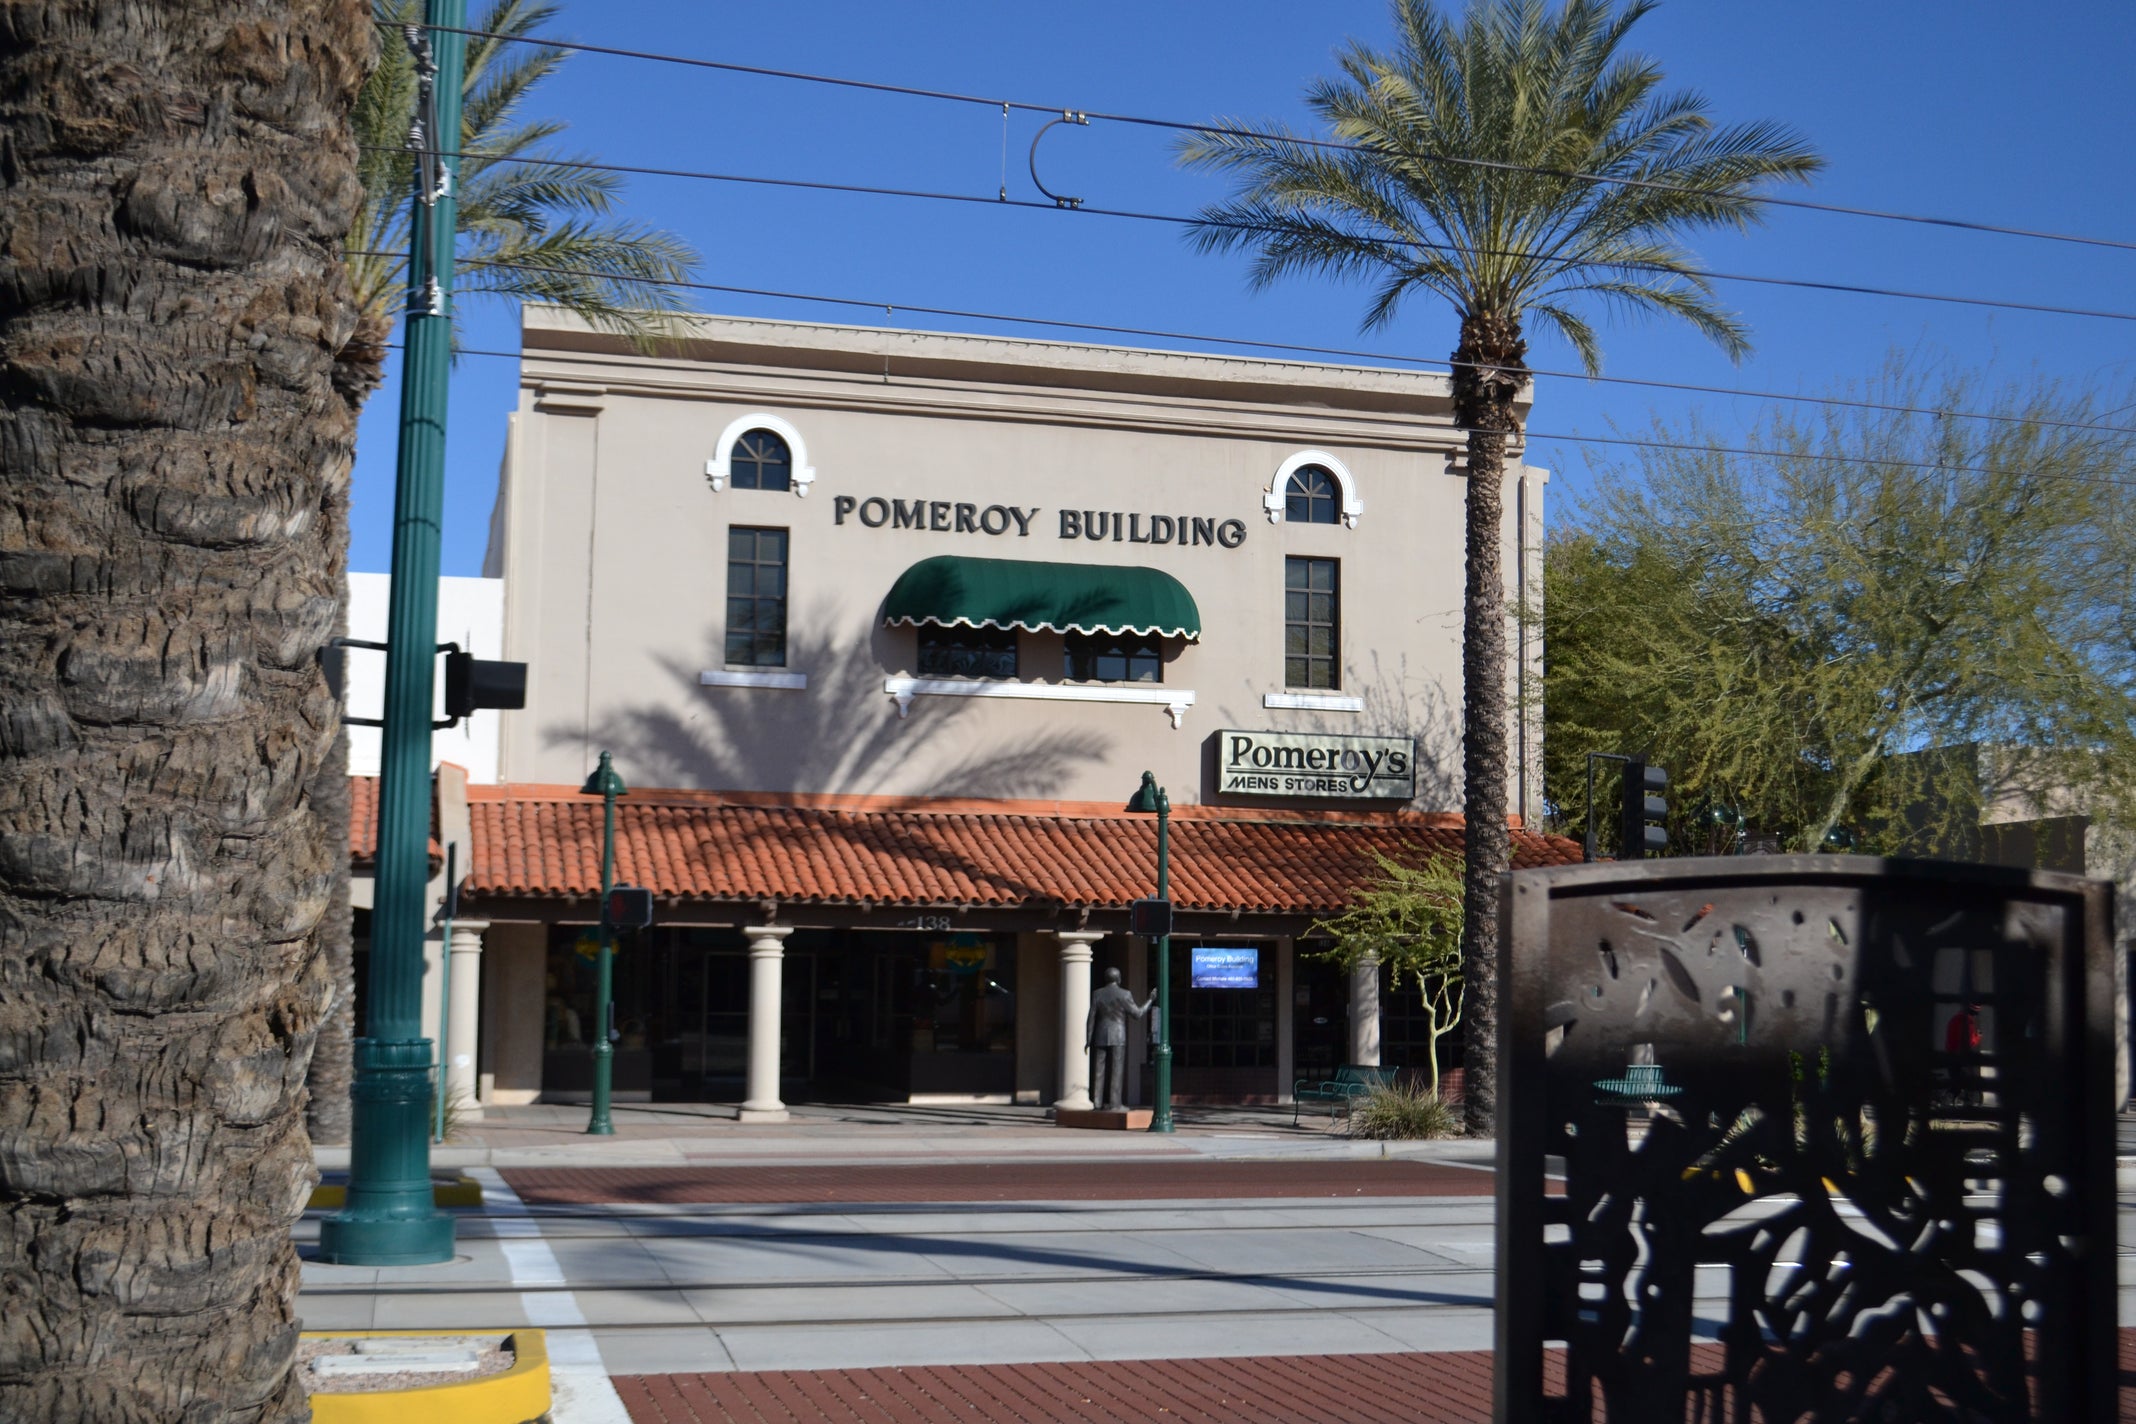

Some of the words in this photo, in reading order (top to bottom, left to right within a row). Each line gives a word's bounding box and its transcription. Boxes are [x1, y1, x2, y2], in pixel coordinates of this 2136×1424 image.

[833, 495, 1040, 536] POMEROY
[1059, 508, 1248, 549] BUILDING
[1230, 736, 1407, 793] Pomeroy's
[1227, 776, 1279, 790] MENS
[1285, 778, 1348, 793] STORES
[917, 915, 951, 931] 138
[1195, 955, 1226, 964] Pomeroy
[1227, 955, 1254, 965] Building
